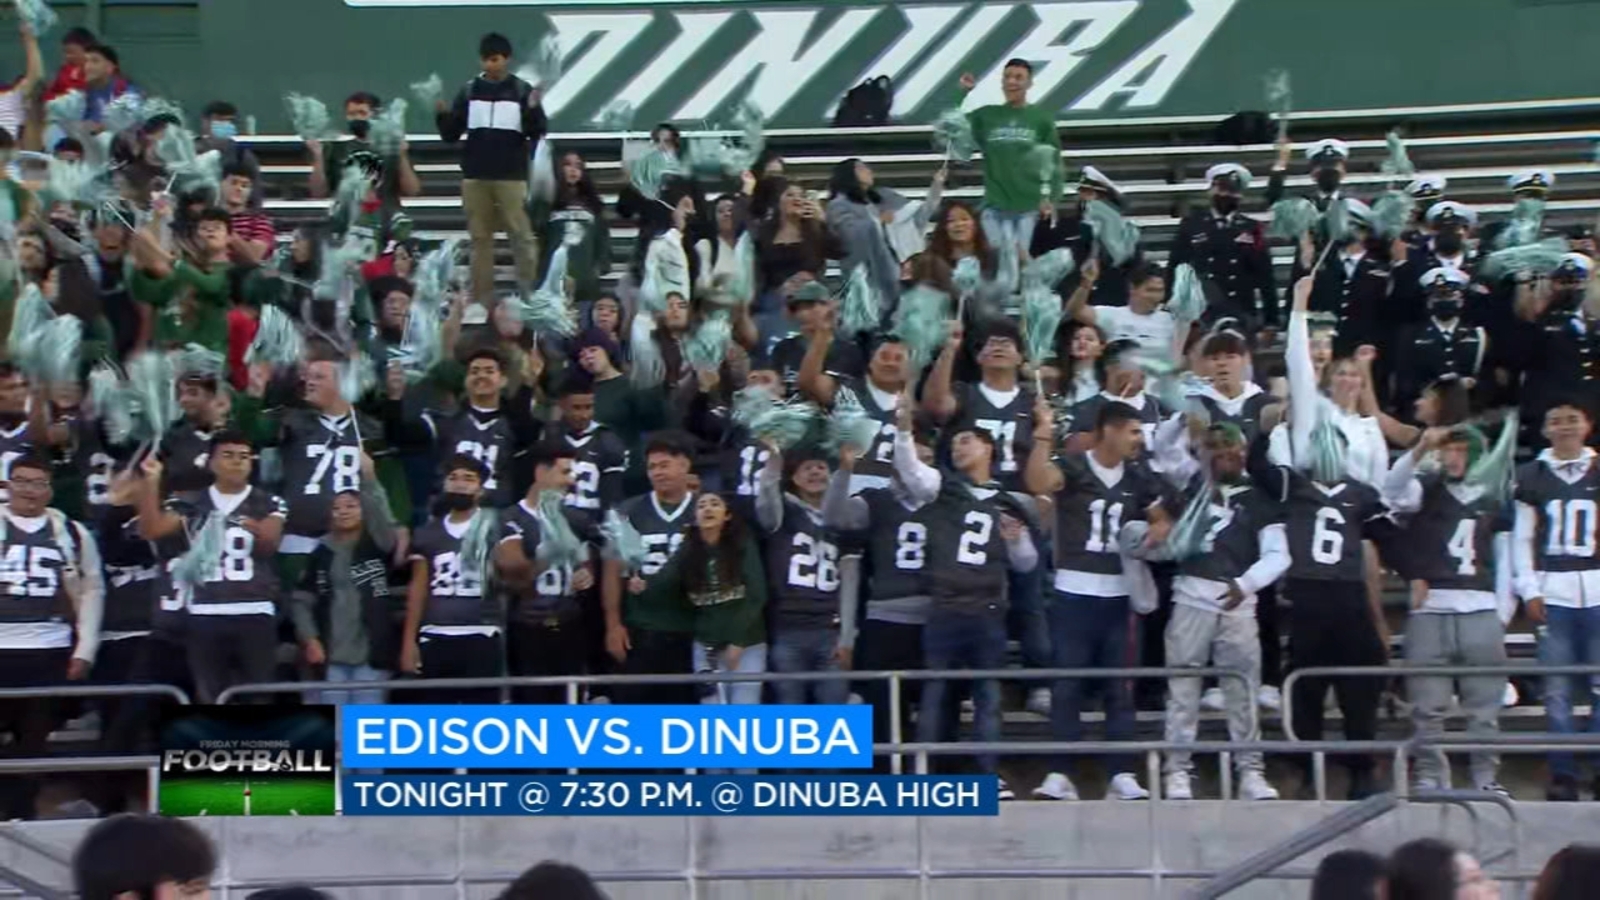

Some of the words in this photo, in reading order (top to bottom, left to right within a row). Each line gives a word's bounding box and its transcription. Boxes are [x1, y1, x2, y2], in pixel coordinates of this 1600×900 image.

[541, 0, 1238, 121] DINUBA
[303, 444, 361, 494] 78
[895, 521, 927, 570] 8
[956, 510, 993, 566] 2
[1085, 499, 1124, 552] 11
[1312, 506, 1346, 565] 6
[1447, 518, 1476, 576] 4
[1545, 499, 1597, 557] 10
[0, 544, 64, 597] 45
